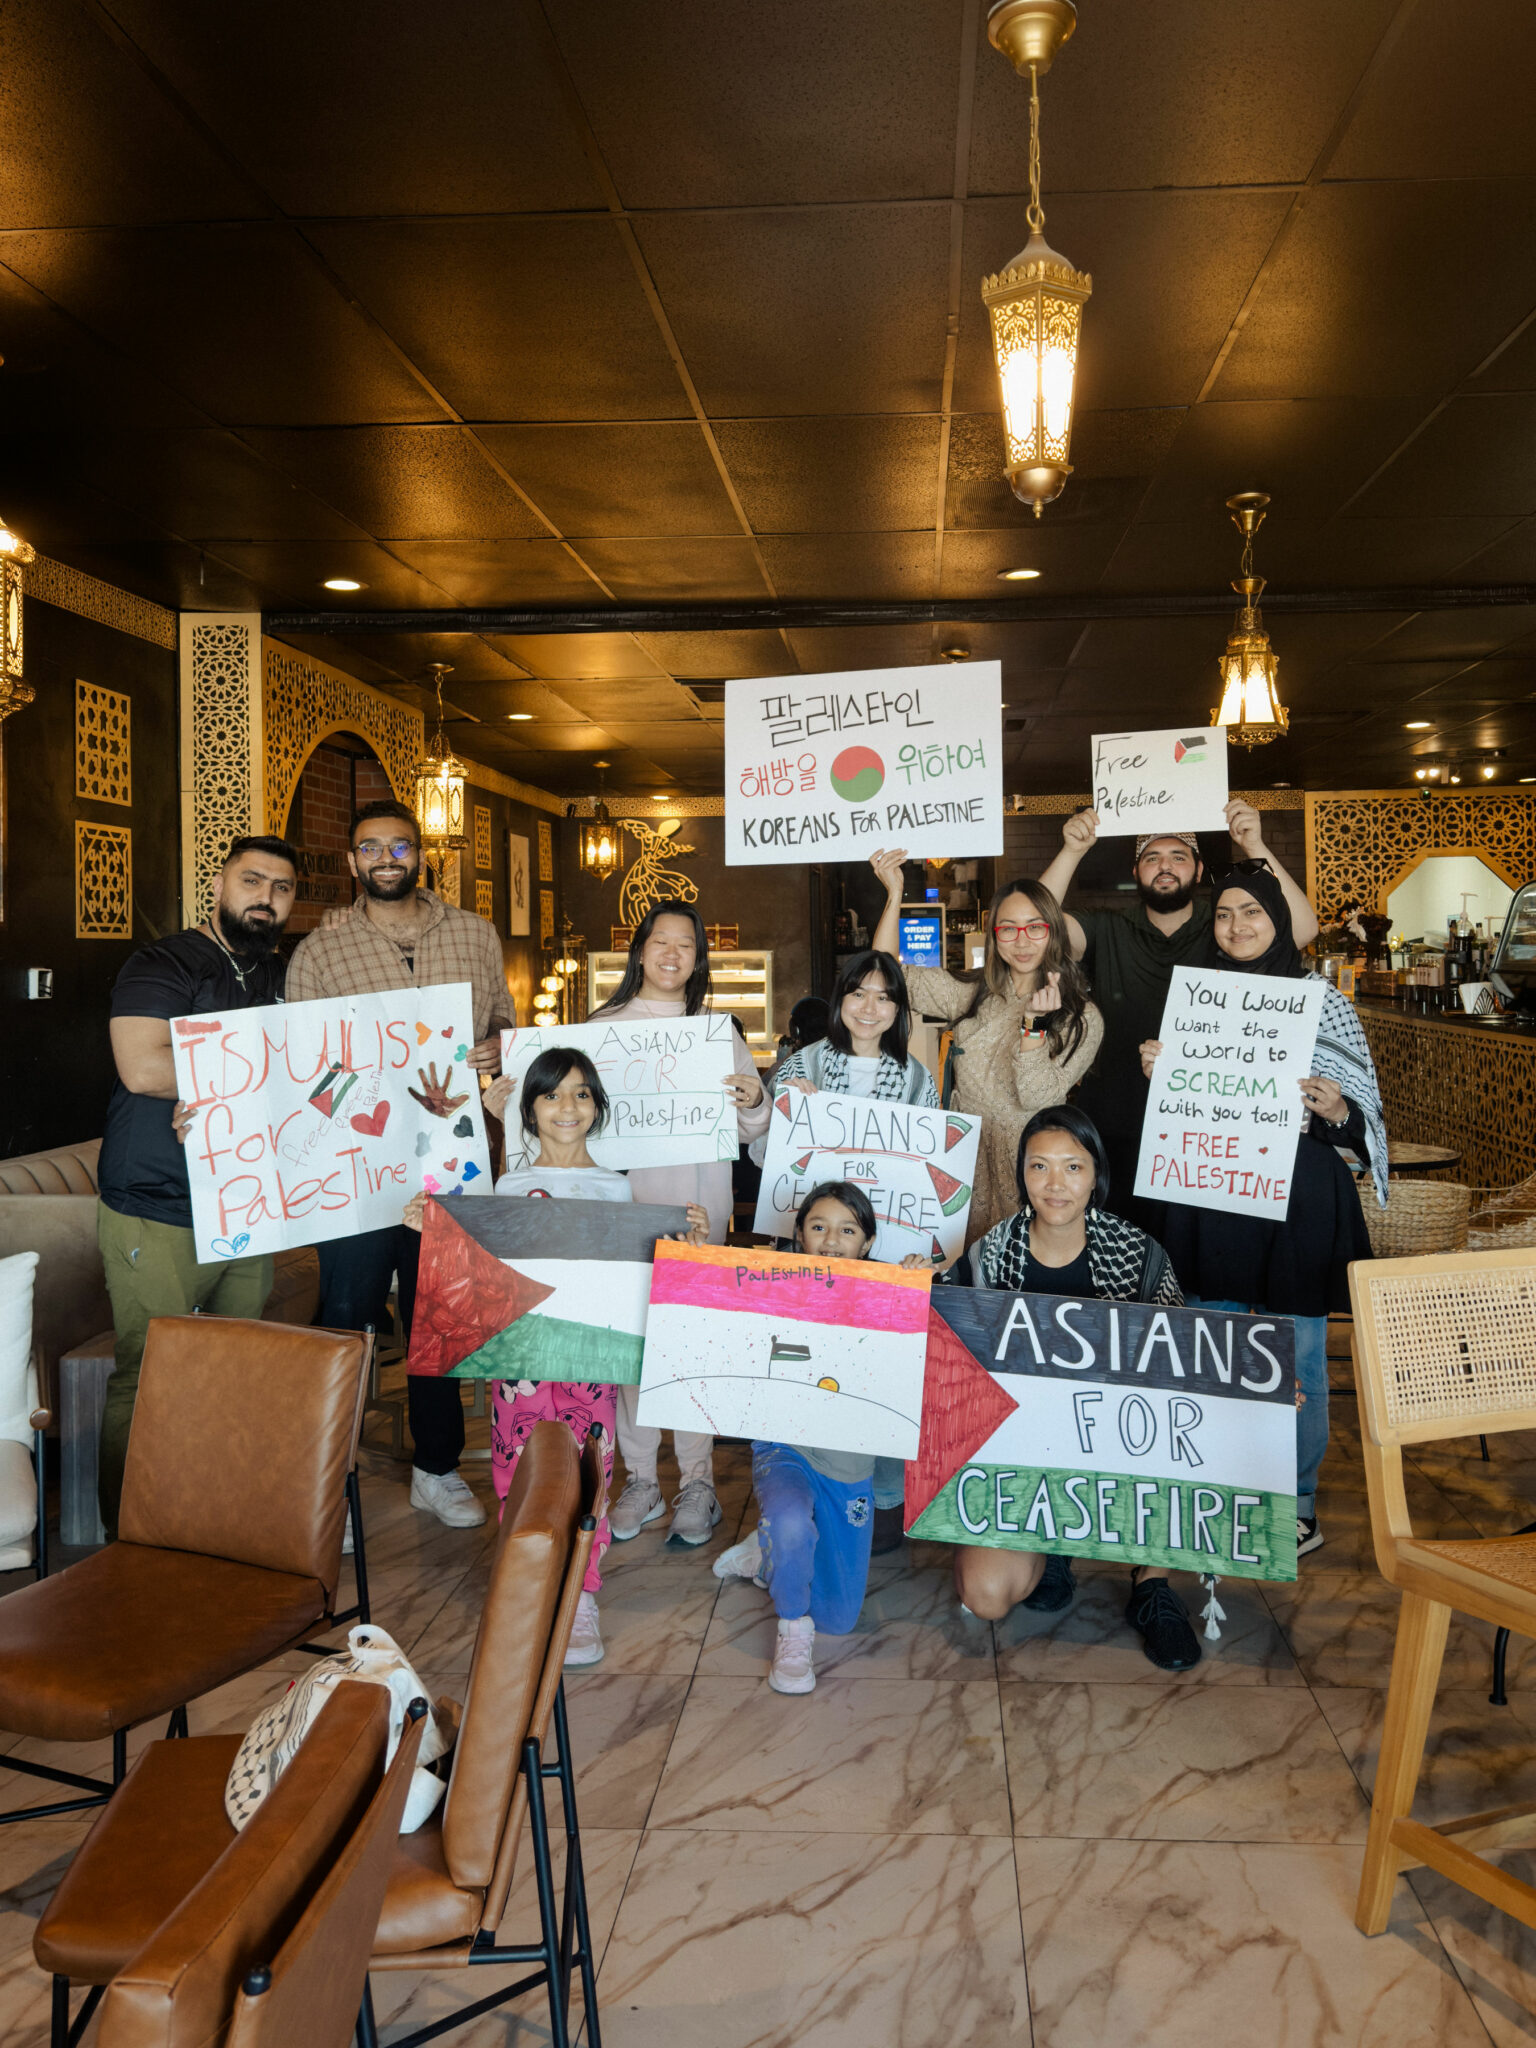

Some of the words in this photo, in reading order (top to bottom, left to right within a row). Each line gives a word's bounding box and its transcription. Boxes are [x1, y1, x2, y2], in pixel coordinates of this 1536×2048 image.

[760, 689, 934, 747] 팔레스타인
[740, 753, 817, 798] 해방을
[896, 739, 986, 785] 위하여
[1095, 736, 1149, 780] Free
[743, 812, 840, 847] KOREANS
[887, 798, 985, 831] PALESTINE
[903, 926, 935, 934] ORDER
[907, 934, 912, 942] &
[914, 934, 932, 942] PAY
[907, 942, 932, 950] HERE
[1185, 981, 1228, 1009] You
[1242, 1022, 1279, 1039] the
[1269, 1046, 1288, 1062] to
[1167, 1069, 1278, 1099] SCREAM
[614, 1098, 718, 1137] Palestine
[786, 1095, 936, 1155] ASIANS
[1211, 1104, 1242, 1122] you
[1251, 1105, 1289, 1127] too!!
[199, 1103, 302, 1175] for
[1182, 1131, 1240, 1159] FREE
[843, 1160, 878, 1179] FOR
[1150, 1154, 1287, 1201] PALESTINE
[772, 1173, 940, 1232] CEFIRE
[994, 1297, 1283, 1394] ASIANS
[1072, 1390, 1204, 1468] FOR
[955, 1466, 1262, 1565] CEASEFIRE
